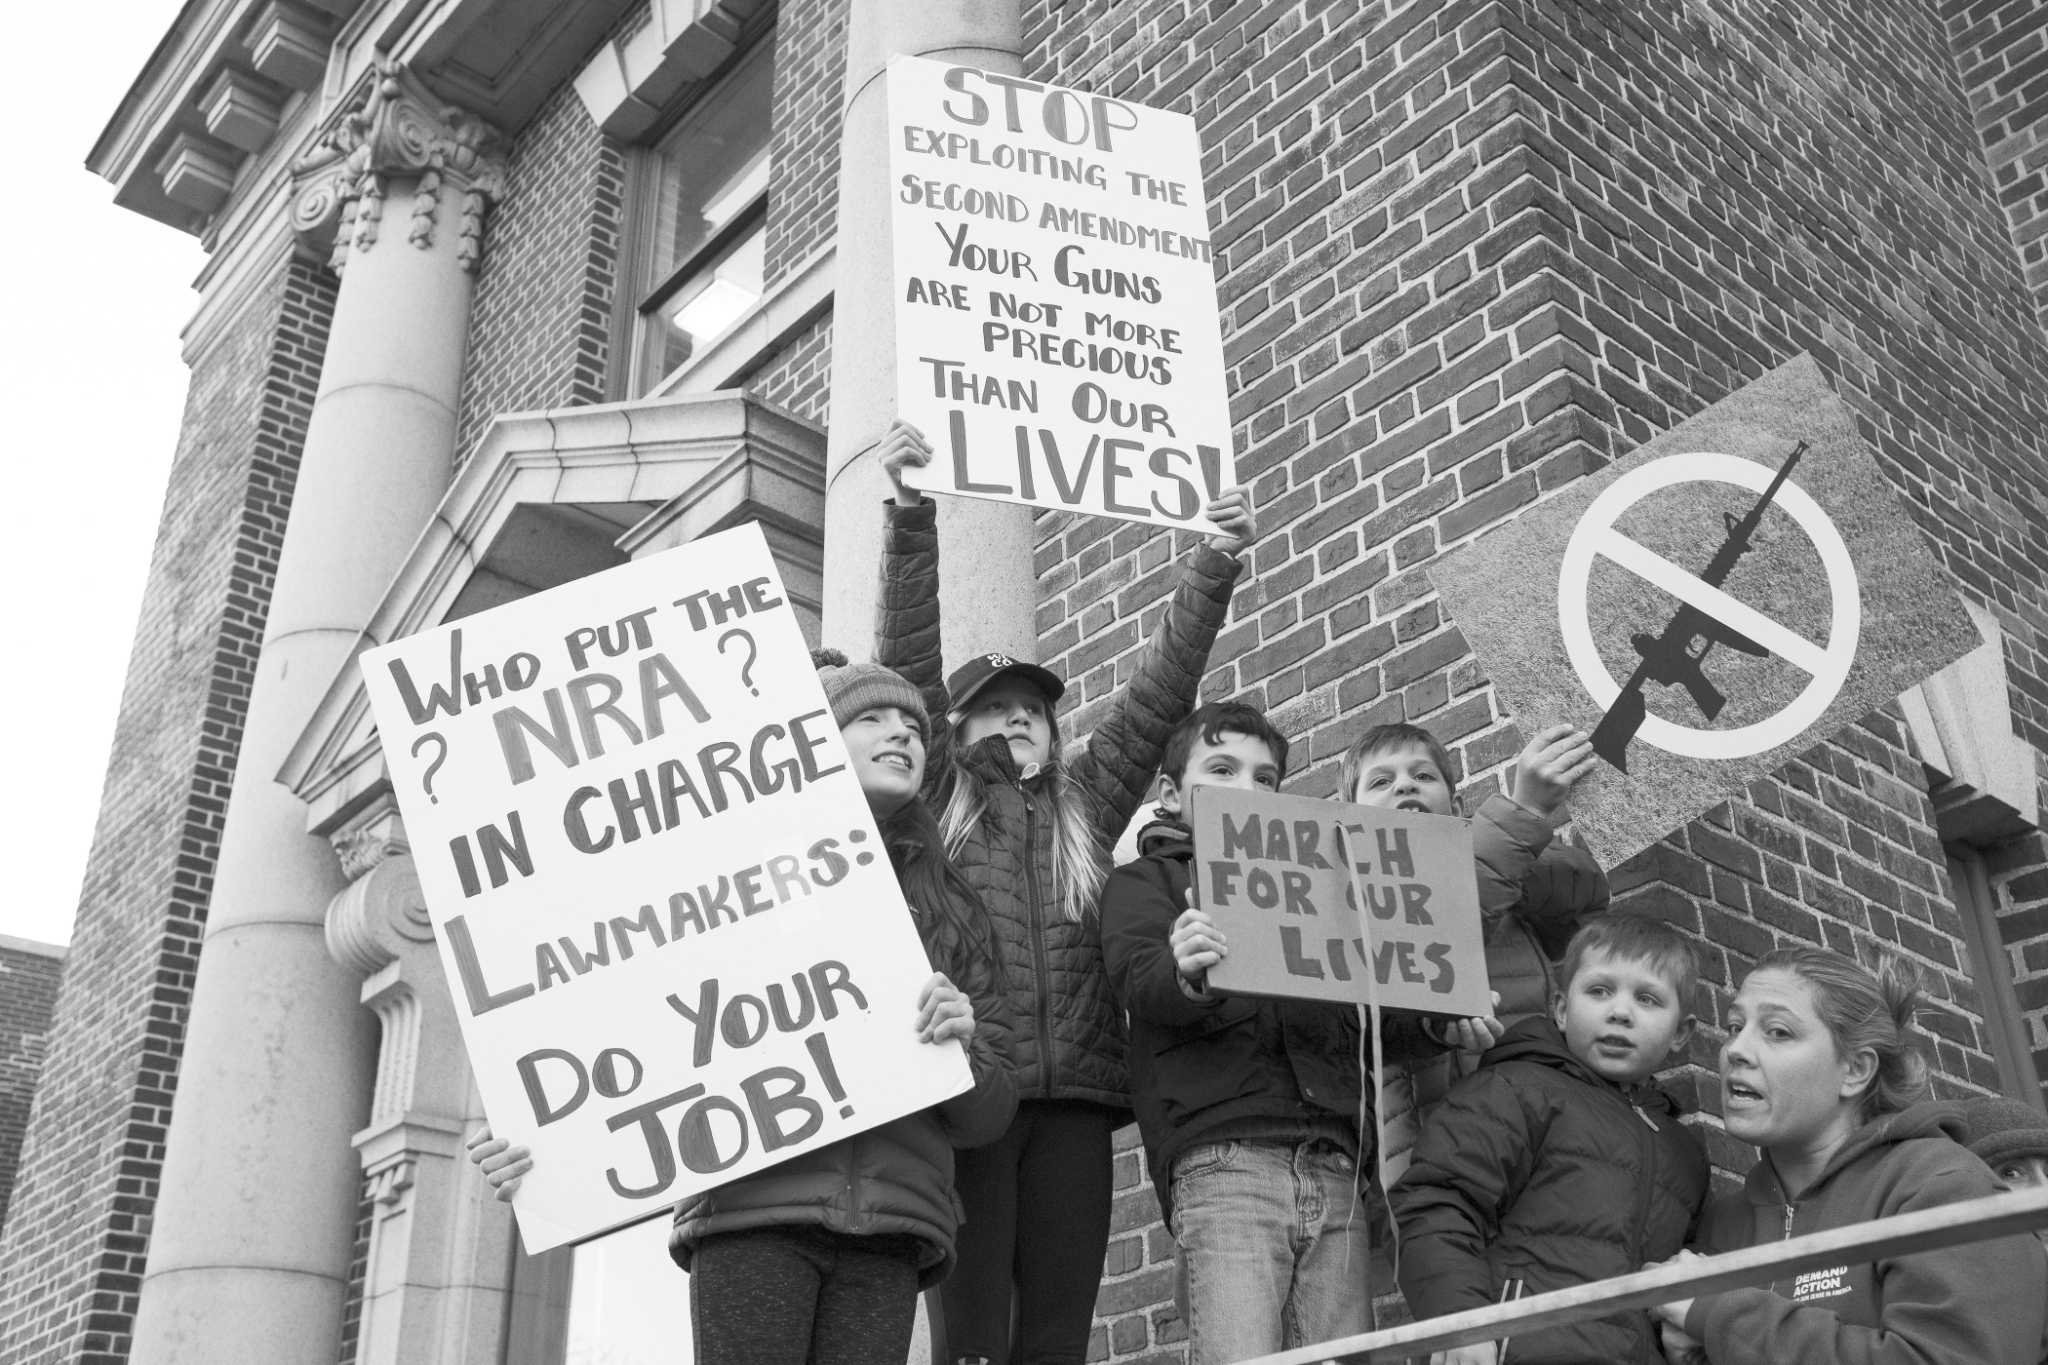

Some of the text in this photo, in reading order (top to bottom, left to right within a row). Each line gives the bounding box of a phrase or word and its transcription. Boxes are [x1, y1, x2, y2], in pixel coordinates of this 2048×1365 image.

[943, 67, 1138, 152] STOP
[904, 125, 1187, 206] EXPLOITING THE
[900, 174, 1212, 263] SECOND AMENDMENT
[935, 221, 1162, 304] YOUR GUNS
[906, 277, 1183, 354] ARE NOT MORE
[983, 322, 1172, 386] PRECIOUS
[919, 357, 1175, 438] THAN OUR
[949, 410, 1221, 520] LIVES!
[388, 576, 783, 726] WHO PUT THE
[411, 628, 759, 804] ? NRA ?
[449, 709, 847, 898] IN CHARGE
[1222, 813, 1415, 878] MARCH
[443, 829, 875, 1017] LAWMAKERS:
[1208, 861, 1318, 916] FOR
[1280, 925, 1455, 994] LIVES
[516, 960, 869, 1127] DO YOUR
[605, 1032, 856, 1200] JOB!
[1793, 1277, 1840, 1297] ACTION
[1795, 1265, 1848, 1286] DEMAND
